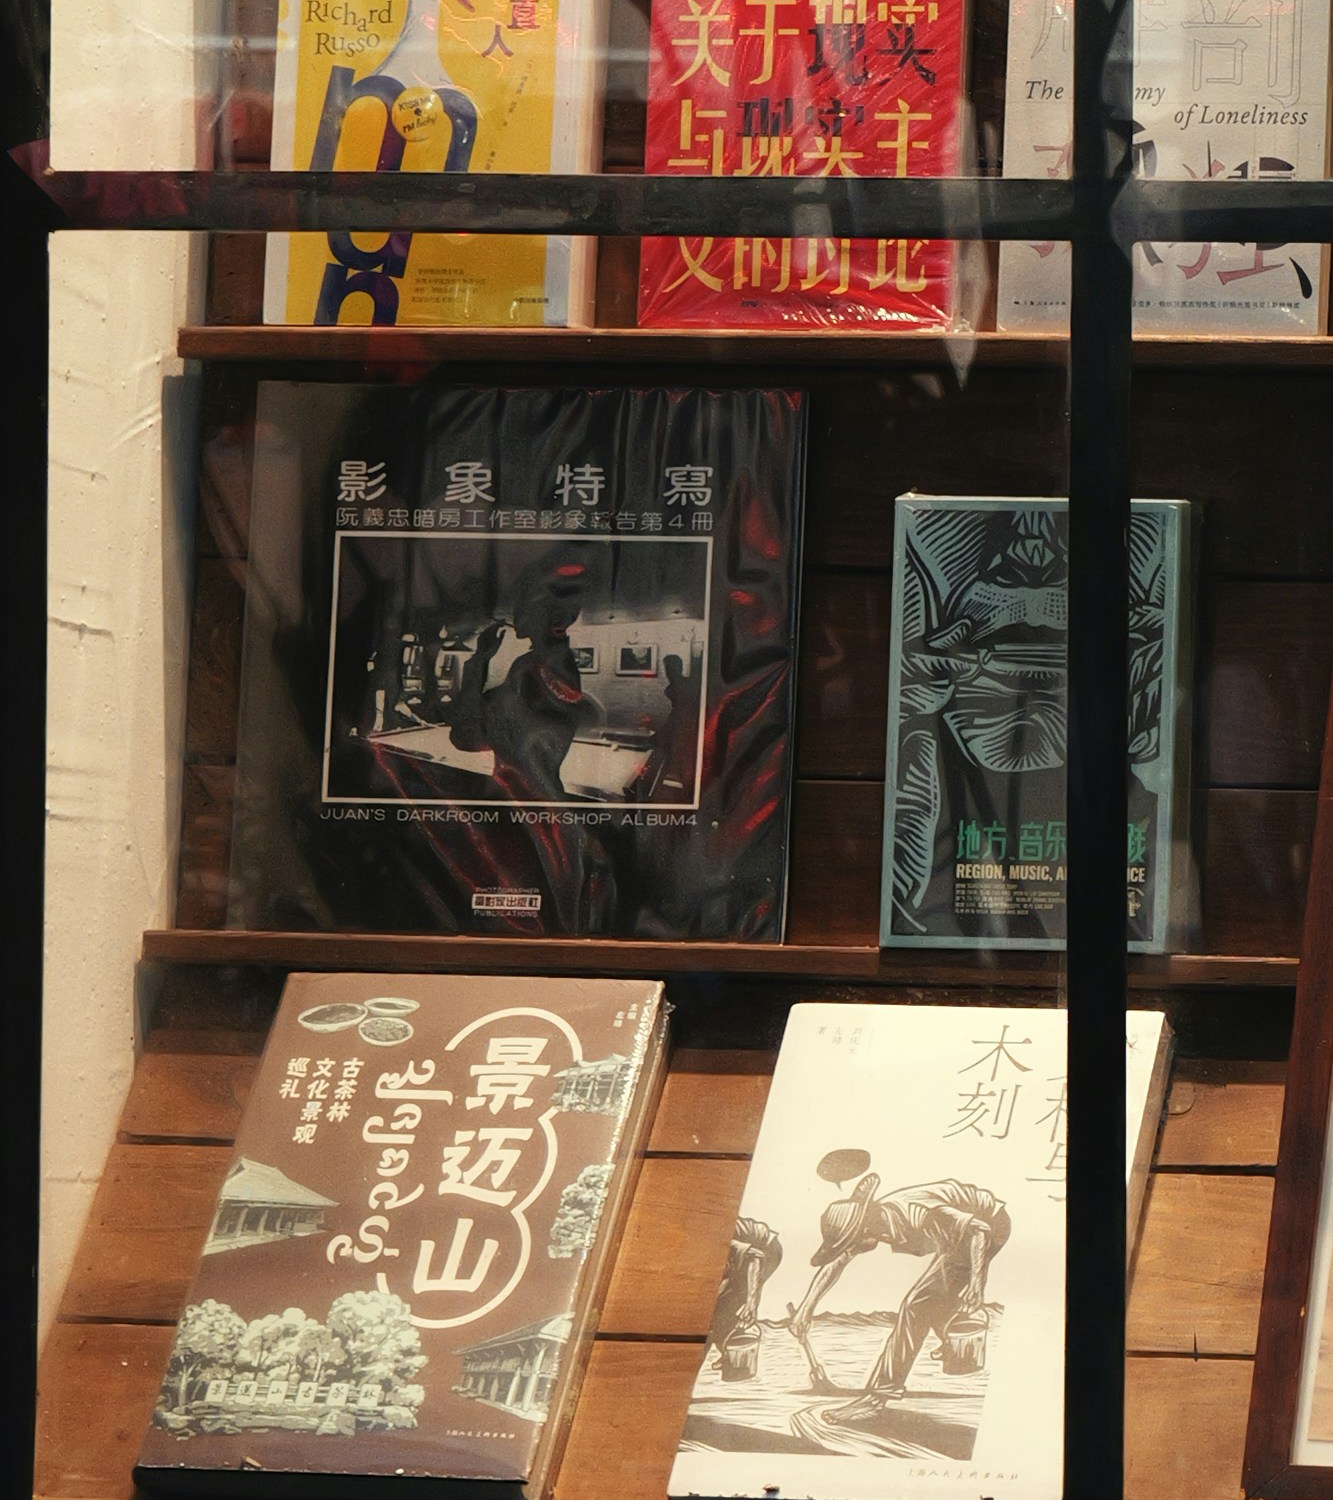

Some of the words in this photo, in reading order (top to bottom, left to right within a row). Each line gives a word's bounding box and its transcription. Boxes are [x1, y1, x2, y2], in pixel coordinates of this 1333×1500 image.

[315, 30, 381, 58] Russo
[1024, 79, 1065, 102] The
[1173, 103, 1198, 132] of
[1199, 103, 1310, 127] Loneliness
[336, 459, 715, 507] 影象特寫
[319, 807, 386, 823] JUAN'S
[397, 809, 499, 824] DARKROOM
[510, 810, 612, 826] WORKSHOP
[956, 863, 1006, 882] REGION,
[1009, 866, 1056, 884] MUSIC,
[280, 1055, 309, 1100] 巡礼
[325, 1055, 367, 1123] 古茶林
[942, 1023, 1034, 1140] 木刻
[292, 1055, 336, 1146] 文化景观
[432, 1034, 553, 1296] 景迈山
